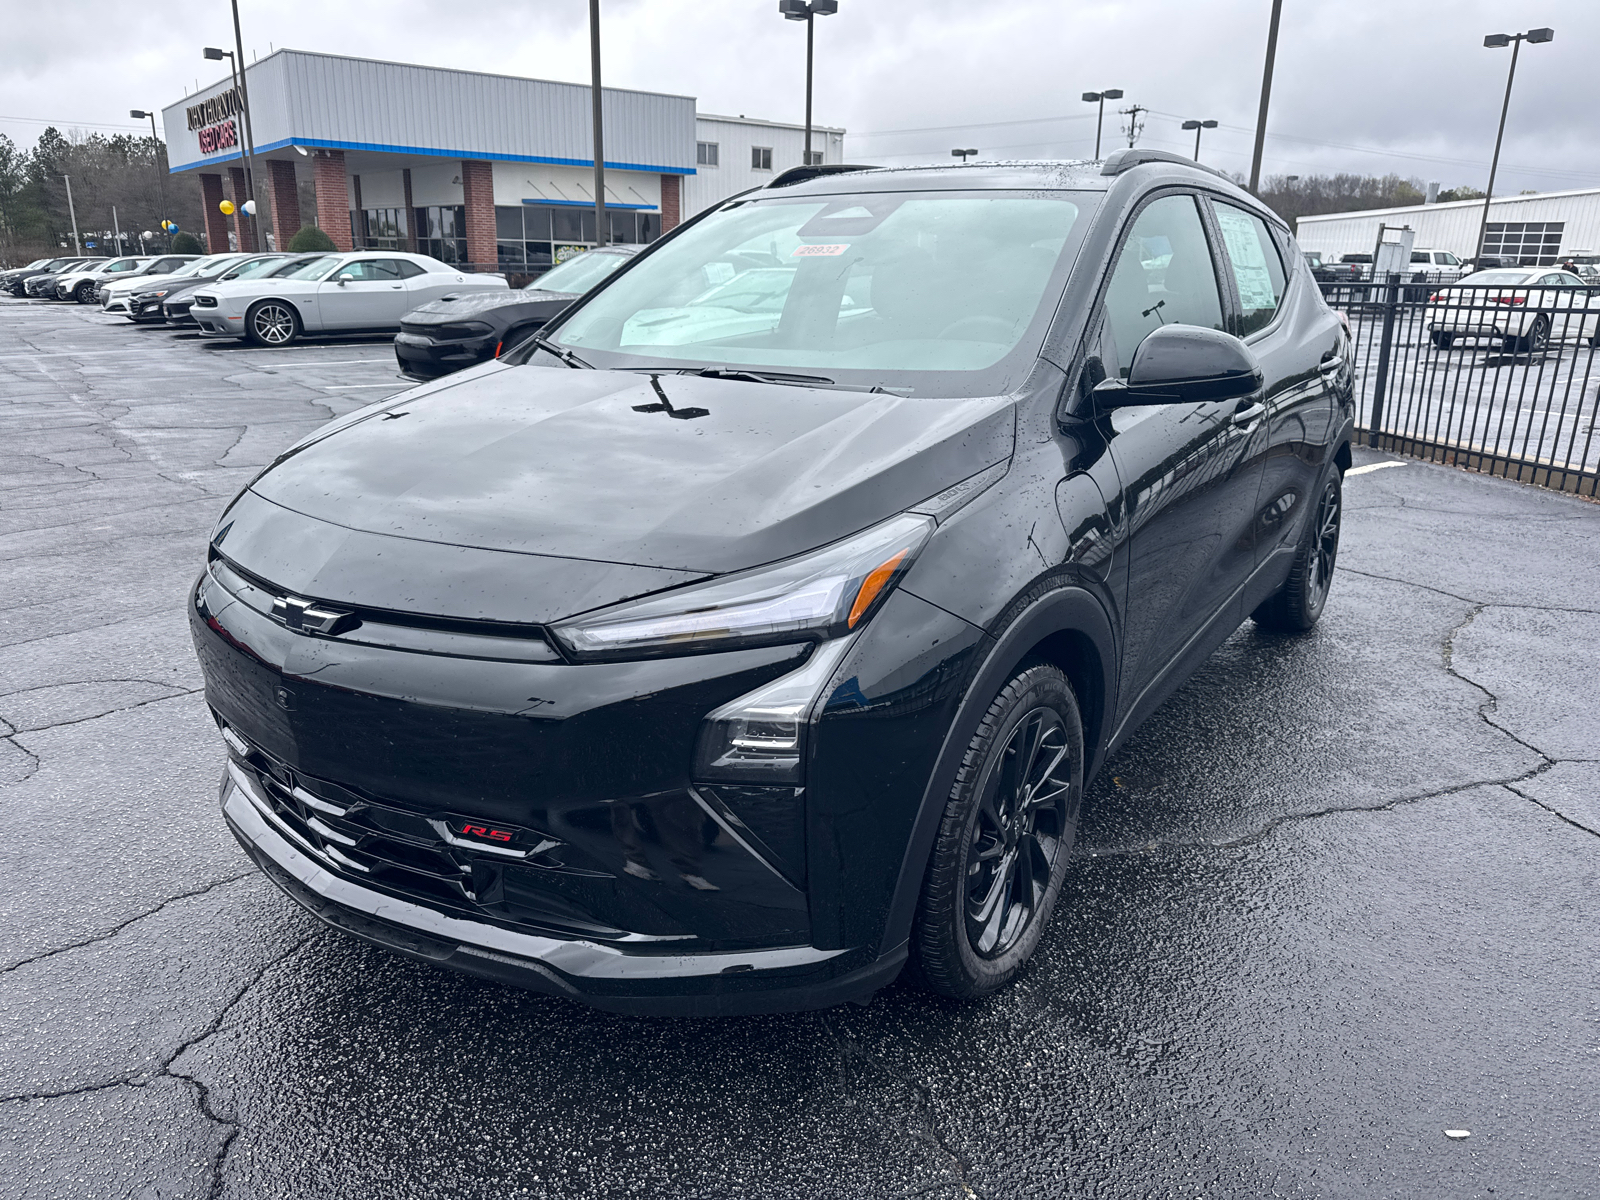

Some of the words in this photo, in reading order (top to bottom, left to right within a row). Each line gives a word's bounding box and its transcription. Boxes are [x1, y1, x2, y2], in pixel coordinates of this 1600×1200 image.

[187, 104, 205, 130] JOHN
[198, 127, 216, 154] USED
[215, 120, 237, 149] CARS
[799, 245, 840, 255] 26932
[937, 481, 970, 501] BOLT
[462, 824, 513, 842] RS
